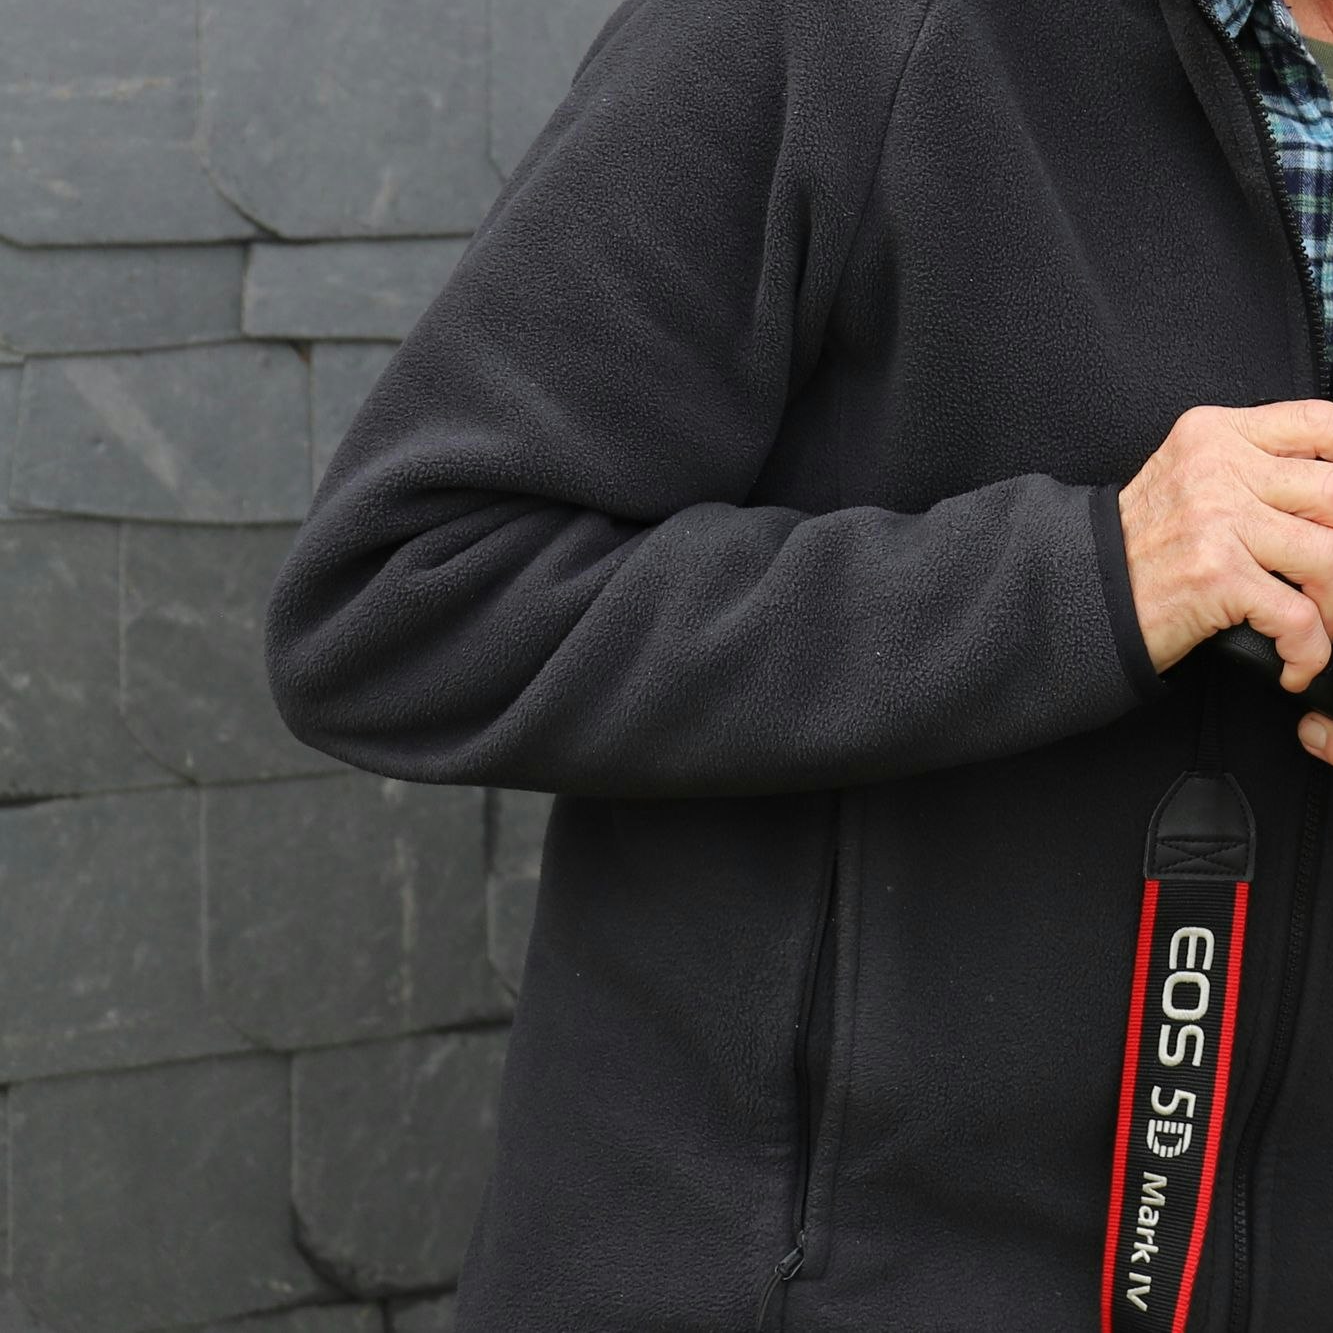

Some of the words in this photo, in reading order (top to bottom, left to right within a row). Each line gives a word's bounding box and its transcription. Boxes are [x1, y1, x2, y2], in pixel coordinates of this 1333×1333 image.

[1158, 926, 1215, 1067] EOS
[1146, 1085, 1196, 1158] 5D
[1131, 1171, 1168, 1264] Mark
[1126, 1271, 1152, 1312] IV
